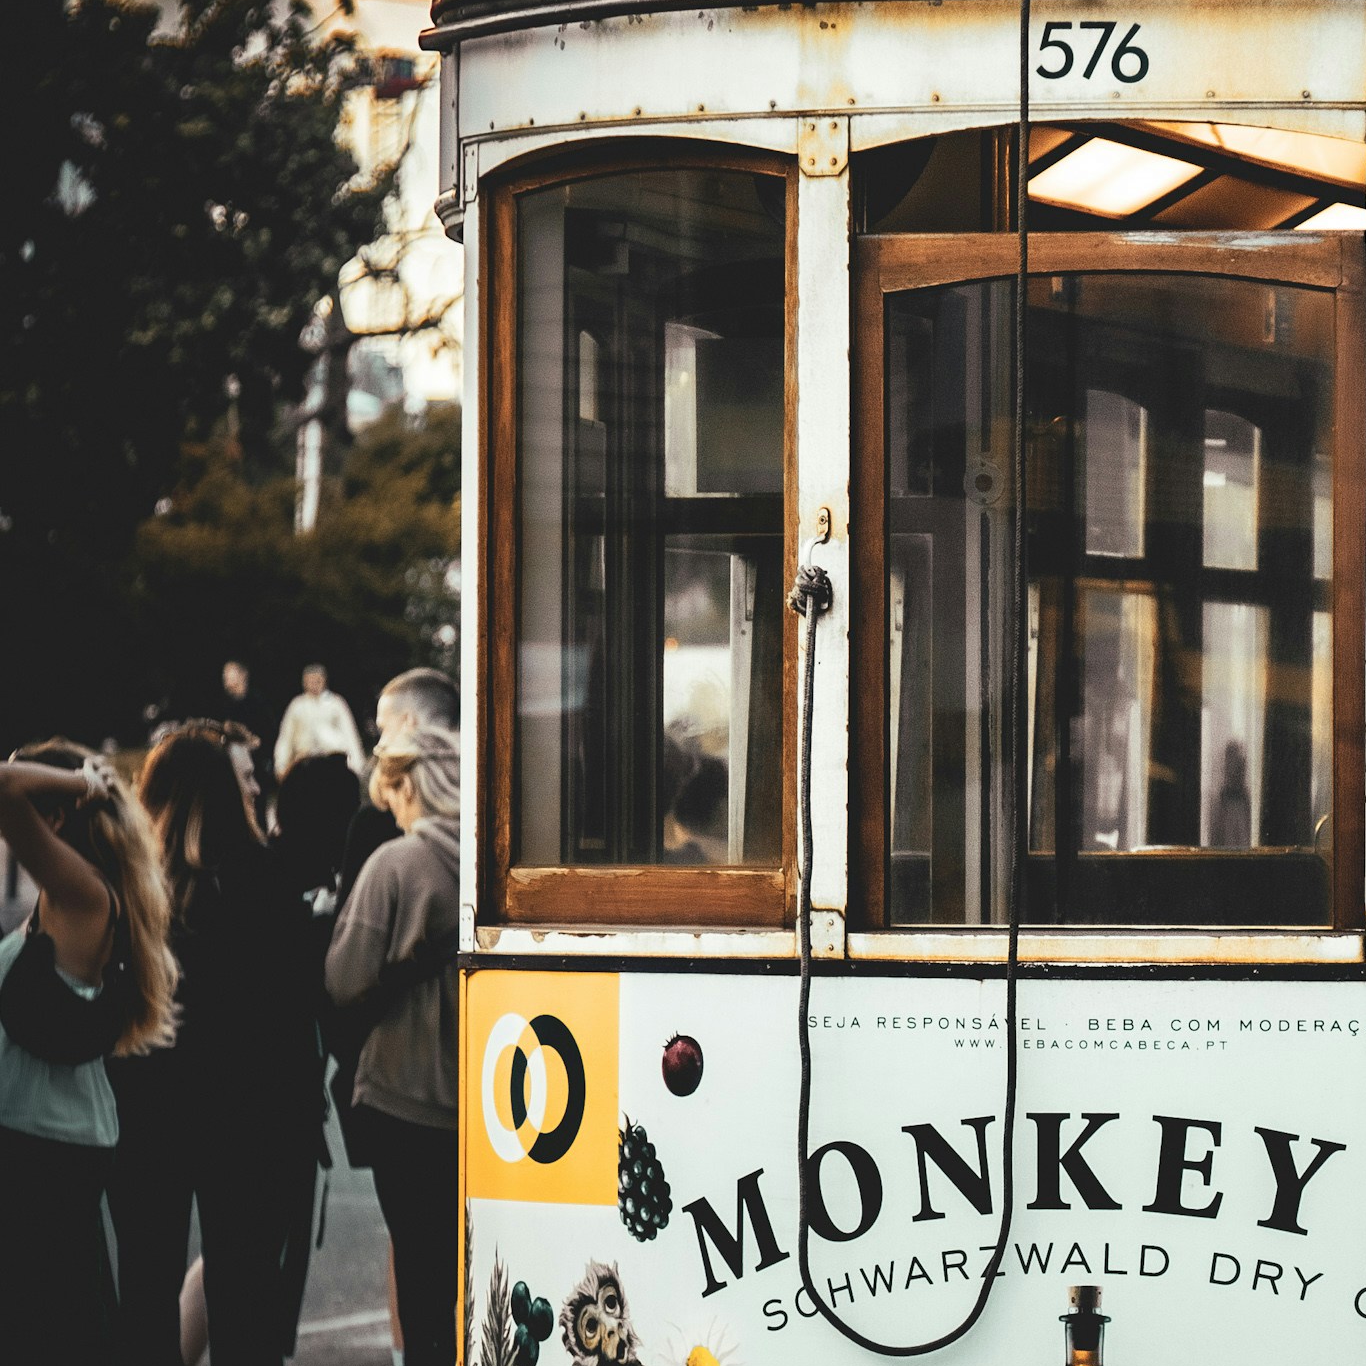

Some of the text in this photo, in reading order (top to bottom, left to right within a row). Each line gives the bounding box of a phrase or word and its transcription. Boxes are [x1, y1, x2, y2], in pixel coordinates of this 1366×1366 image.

[1035, 20, 1150, 84] 576
[807, 1016, 861, 1029] SEJA
[1088, 1018, 1152, 1031] BEBA
[1171, 1019, 1221, 1032] COM
[954, 1038, 1228, 1051] WWW.EBACOMCABECA.PT
[682, 1112, 1347, 1298] MONKEY
[762, 1242, 1170, 1331] SCHWARZWALD
[1209, 1252, 1324, 1302] DRY
